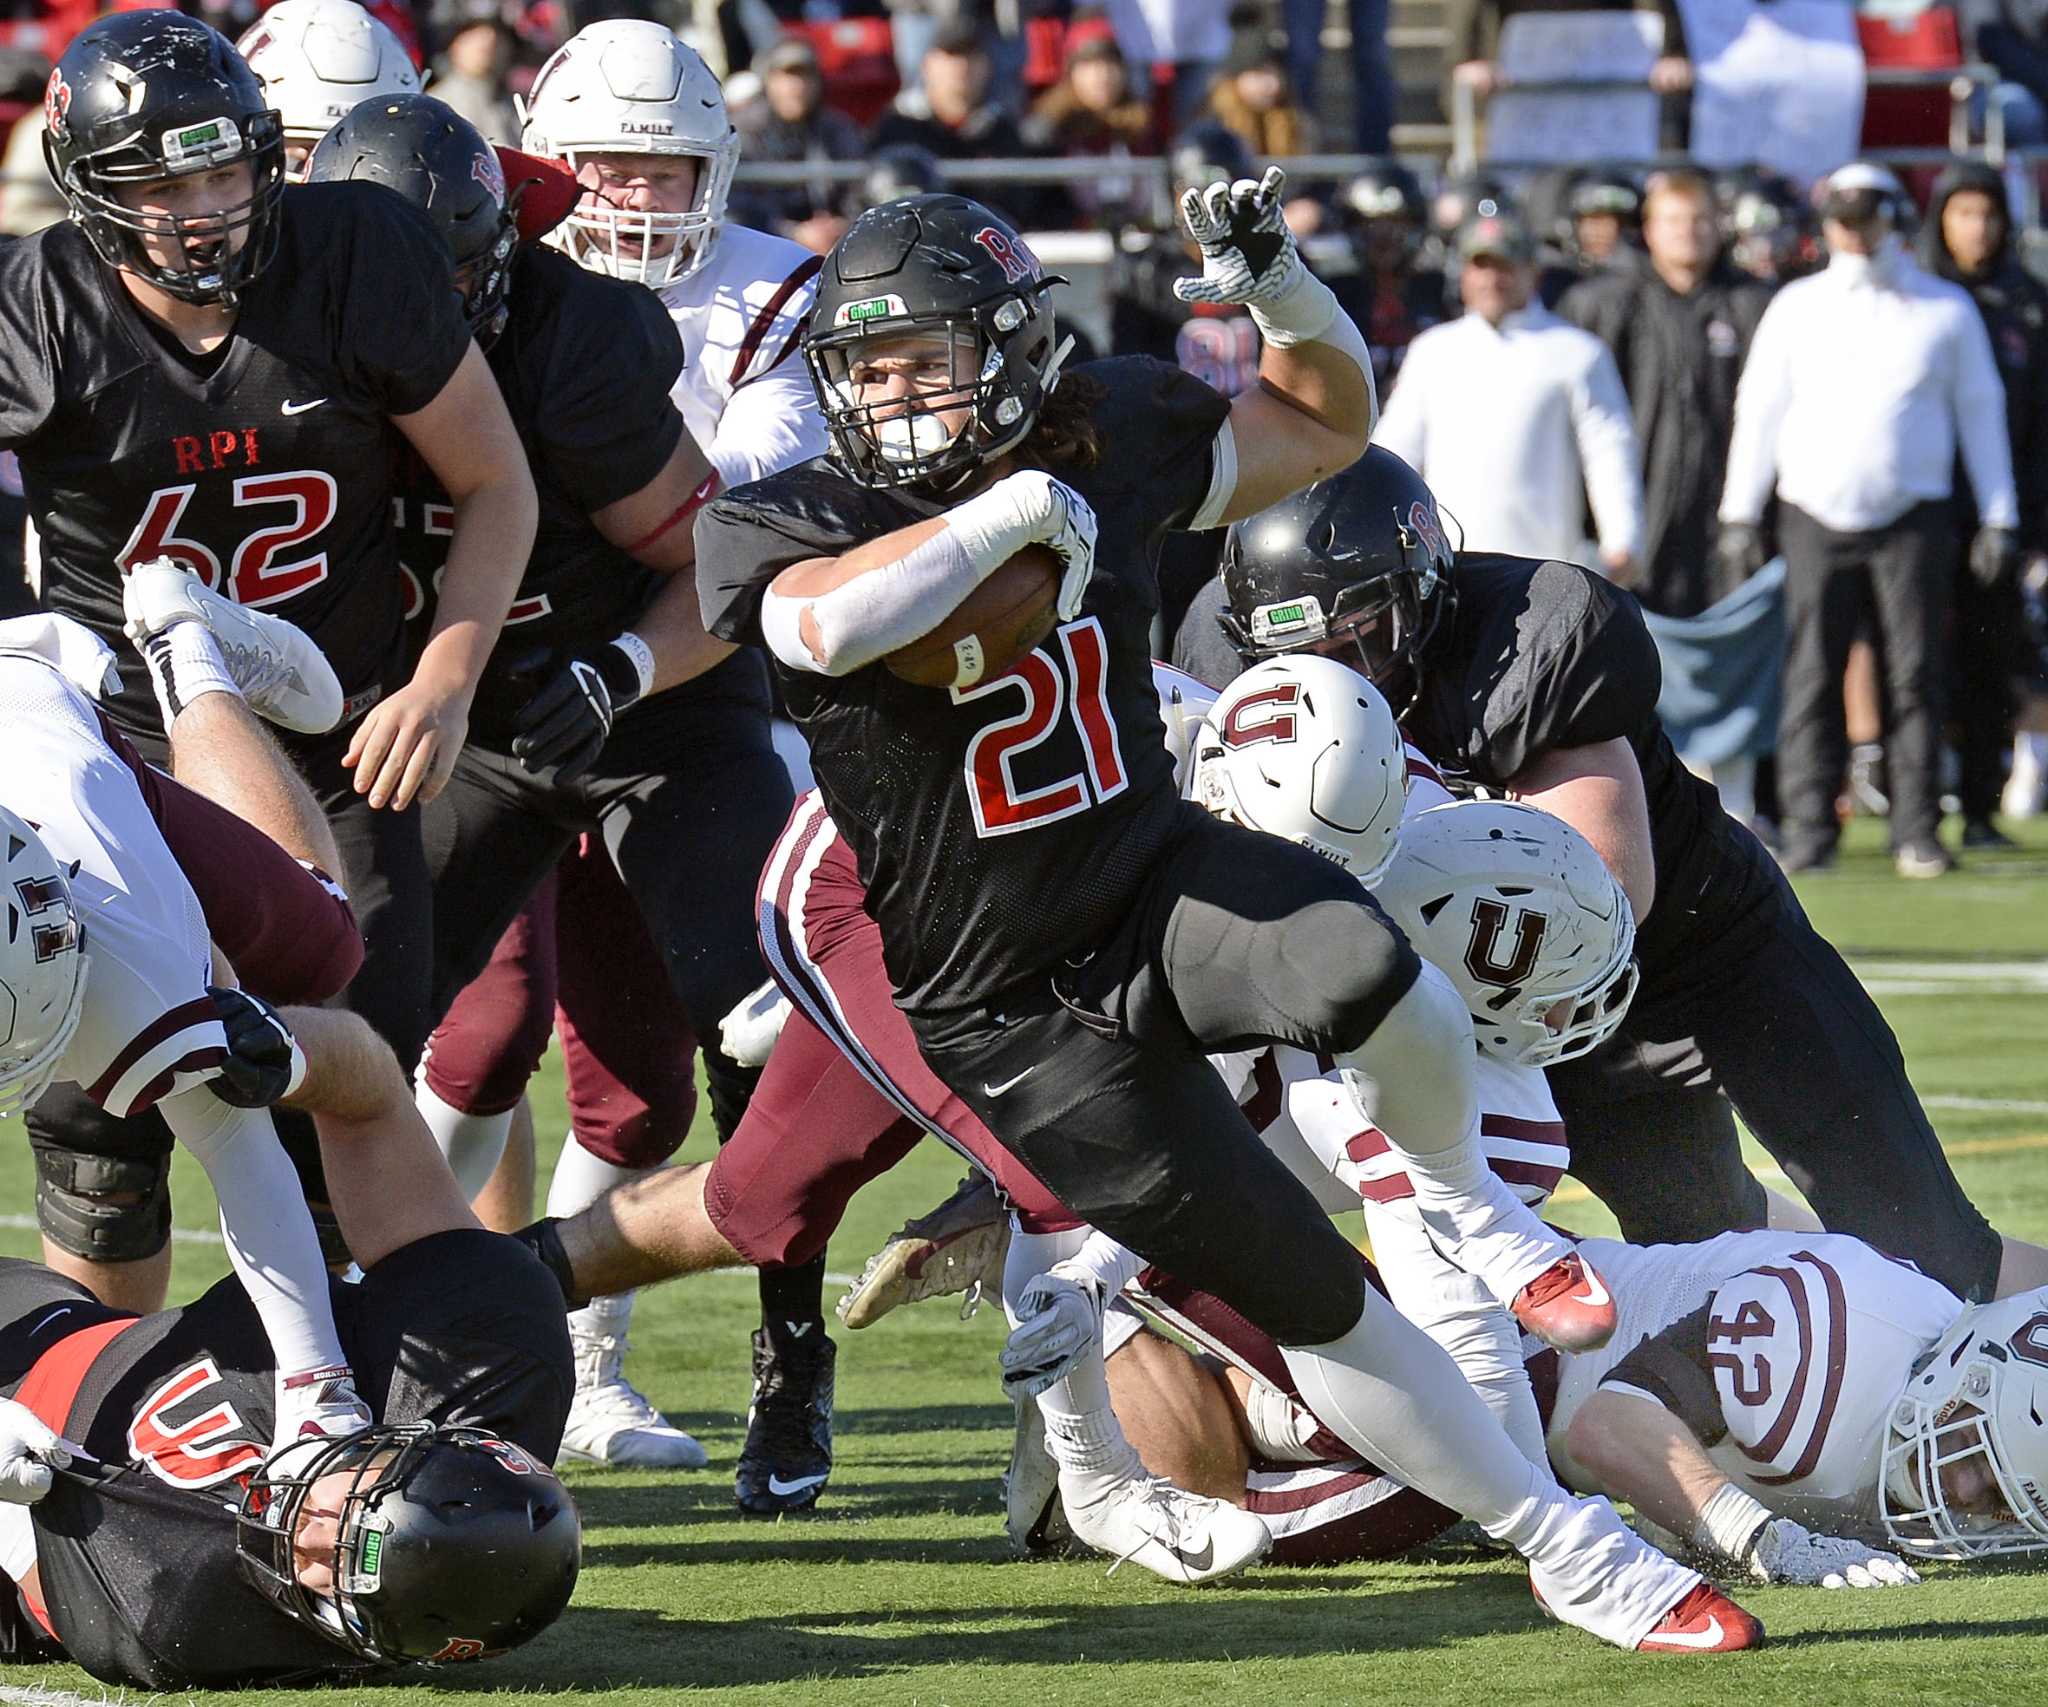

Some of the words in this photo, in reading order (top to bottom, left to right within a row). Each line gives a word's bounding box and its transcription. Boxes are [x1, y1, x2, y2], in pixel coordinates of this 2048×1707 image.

[620, 122, 673, 136] FAMILY
[170, 427, 261, 475] RPI
[113, 469, 338, 608] 62
[1269, 604, 1304, 625] GRIND
[950, 615, 1129, 839] 21
[1220, 683, 1301, 752] U
[1464, 897, 1547, 989] U
[1706, 1300, 1776, 1407] 42
[364, 1531, 381, 1574] GRIND
